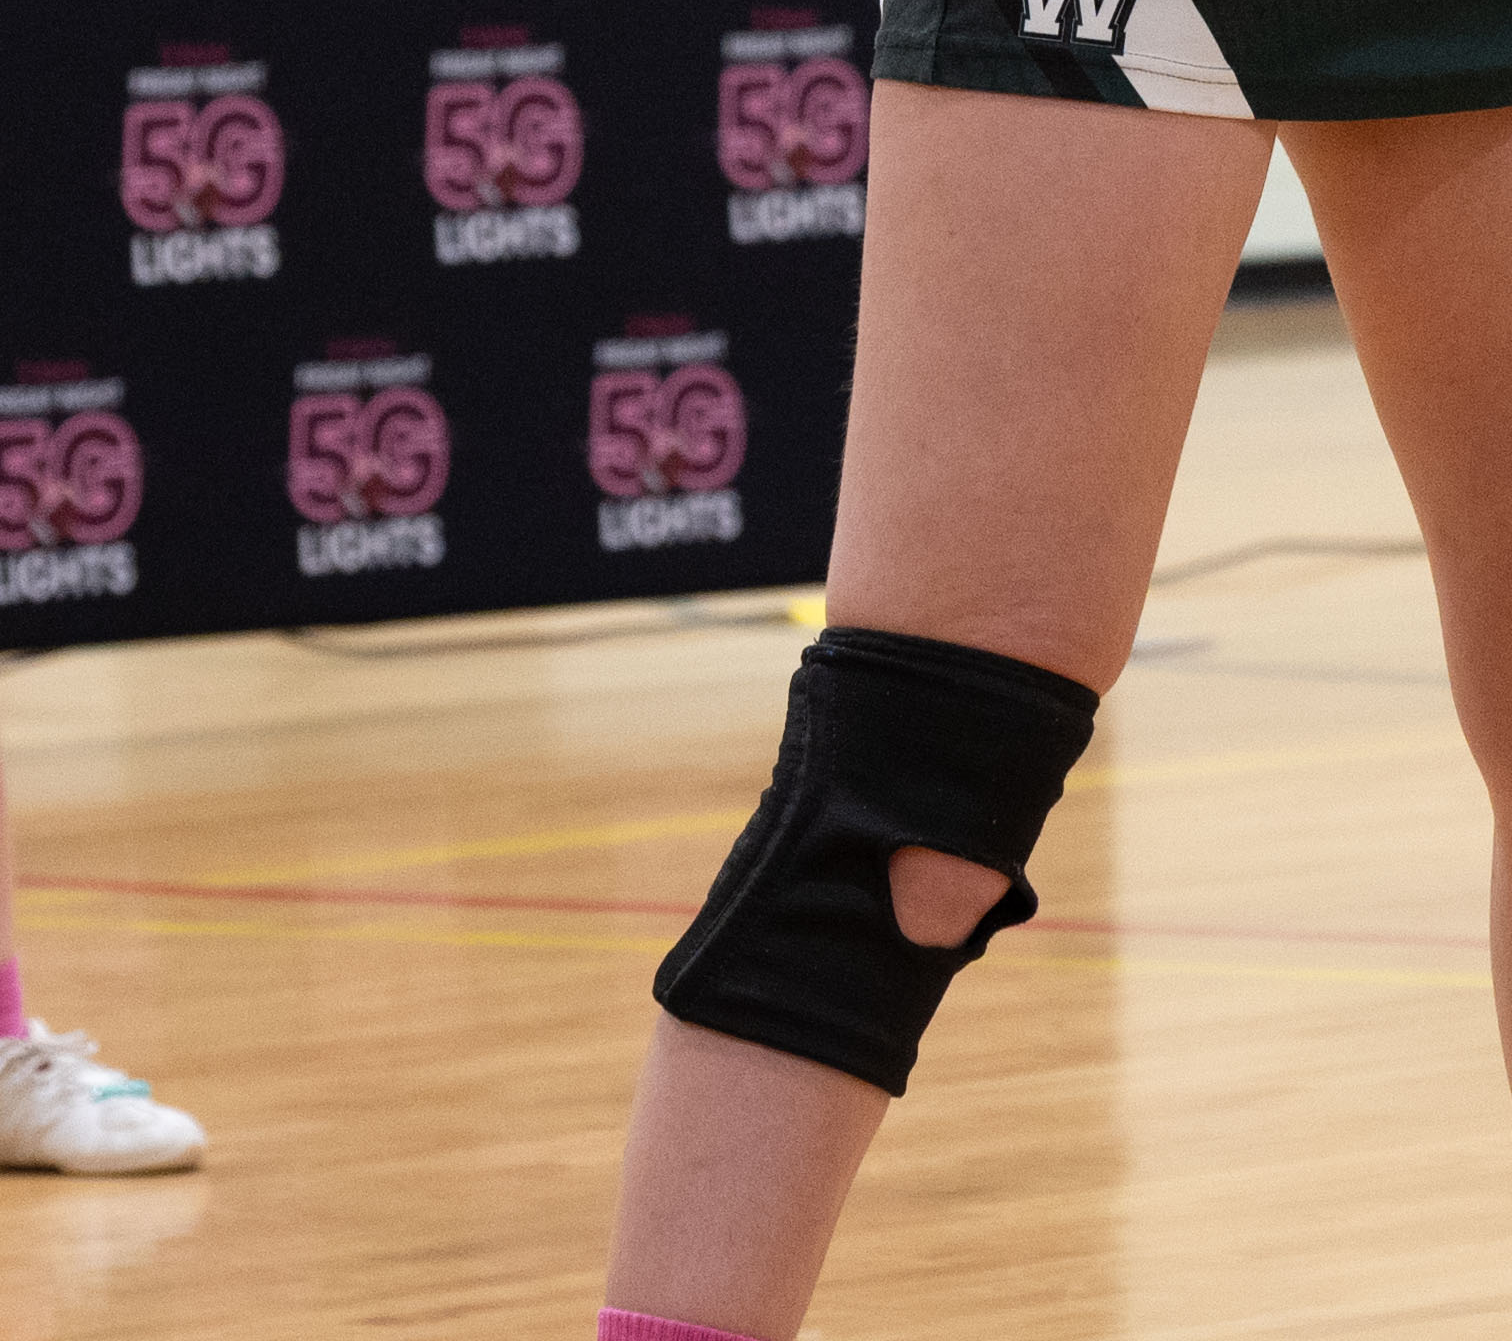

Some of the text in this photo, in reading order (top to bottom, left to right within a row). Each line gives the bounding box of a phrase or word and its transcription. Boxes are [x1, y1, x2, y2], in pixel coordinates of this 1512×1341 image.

[122, 96, 284, 230] 5G
[426, 78, 582, 210] 5G
[130, 226, 280, 286] LIGHTS
[434, 206, 580, 265] LIGHTS
[289, 388, 449, 522] 5G
[589, 364, 745, 496] 5G
[297, 515, 445, 576] LIGHTS
[598, 488, 743, 551] LIGHTS
